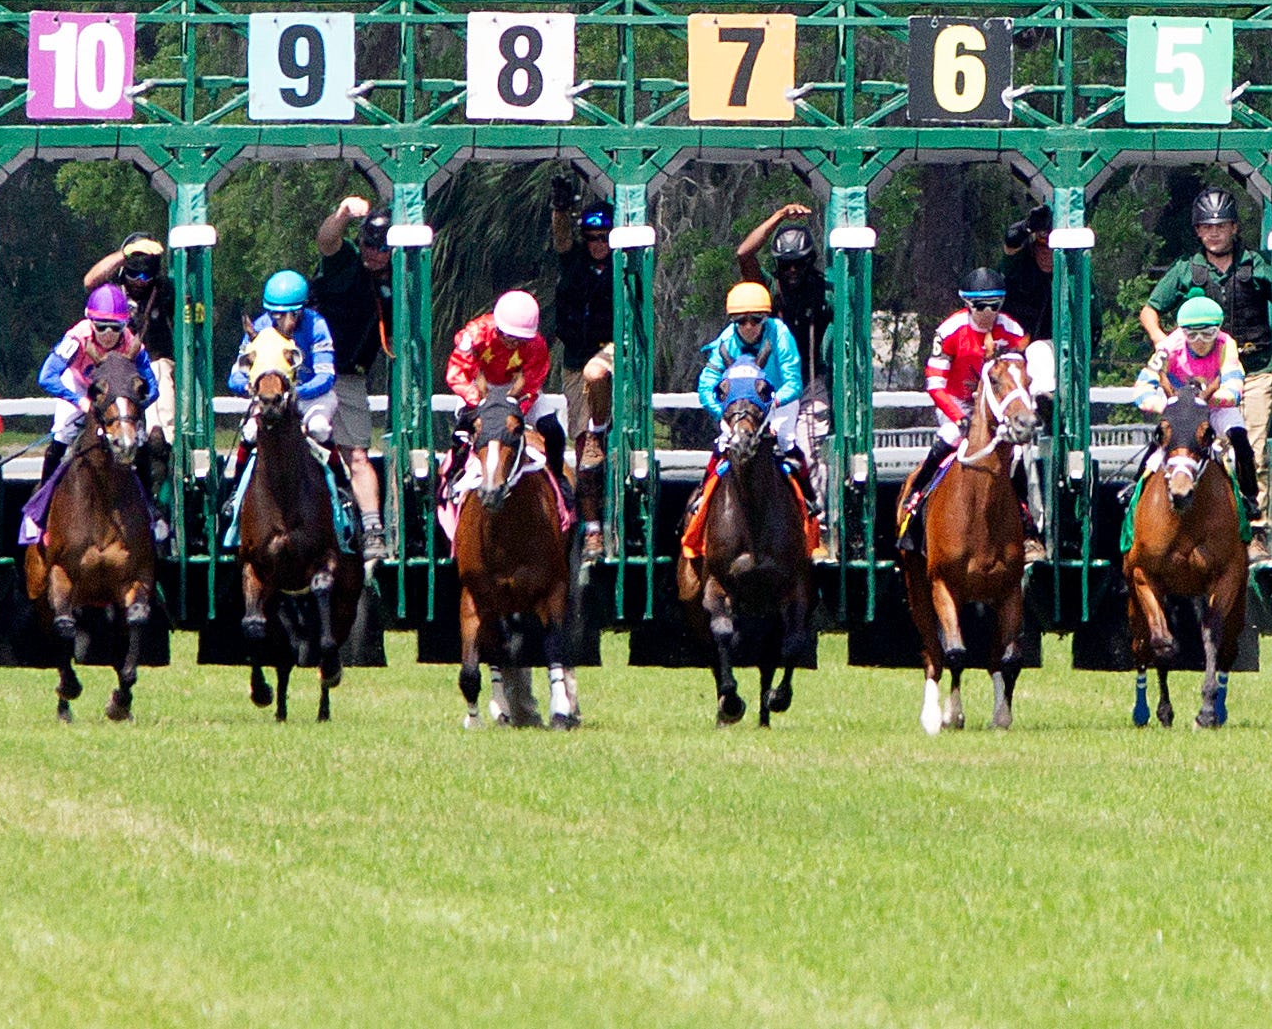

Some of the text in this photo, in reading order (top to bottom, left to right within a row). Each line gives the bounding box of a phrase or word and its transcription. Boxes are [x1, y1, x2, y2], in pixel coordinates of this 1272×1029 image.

[39, 20, 125, 110] 10
[279, 25, 324, 107] 9
[498, 26, 542, 106] 8
[720, 28, 764, 106] 7
[933, 25, 986, 112] 6
[1153, 27, 1205, 112] 5
[932, 335, 942, 356] 6
